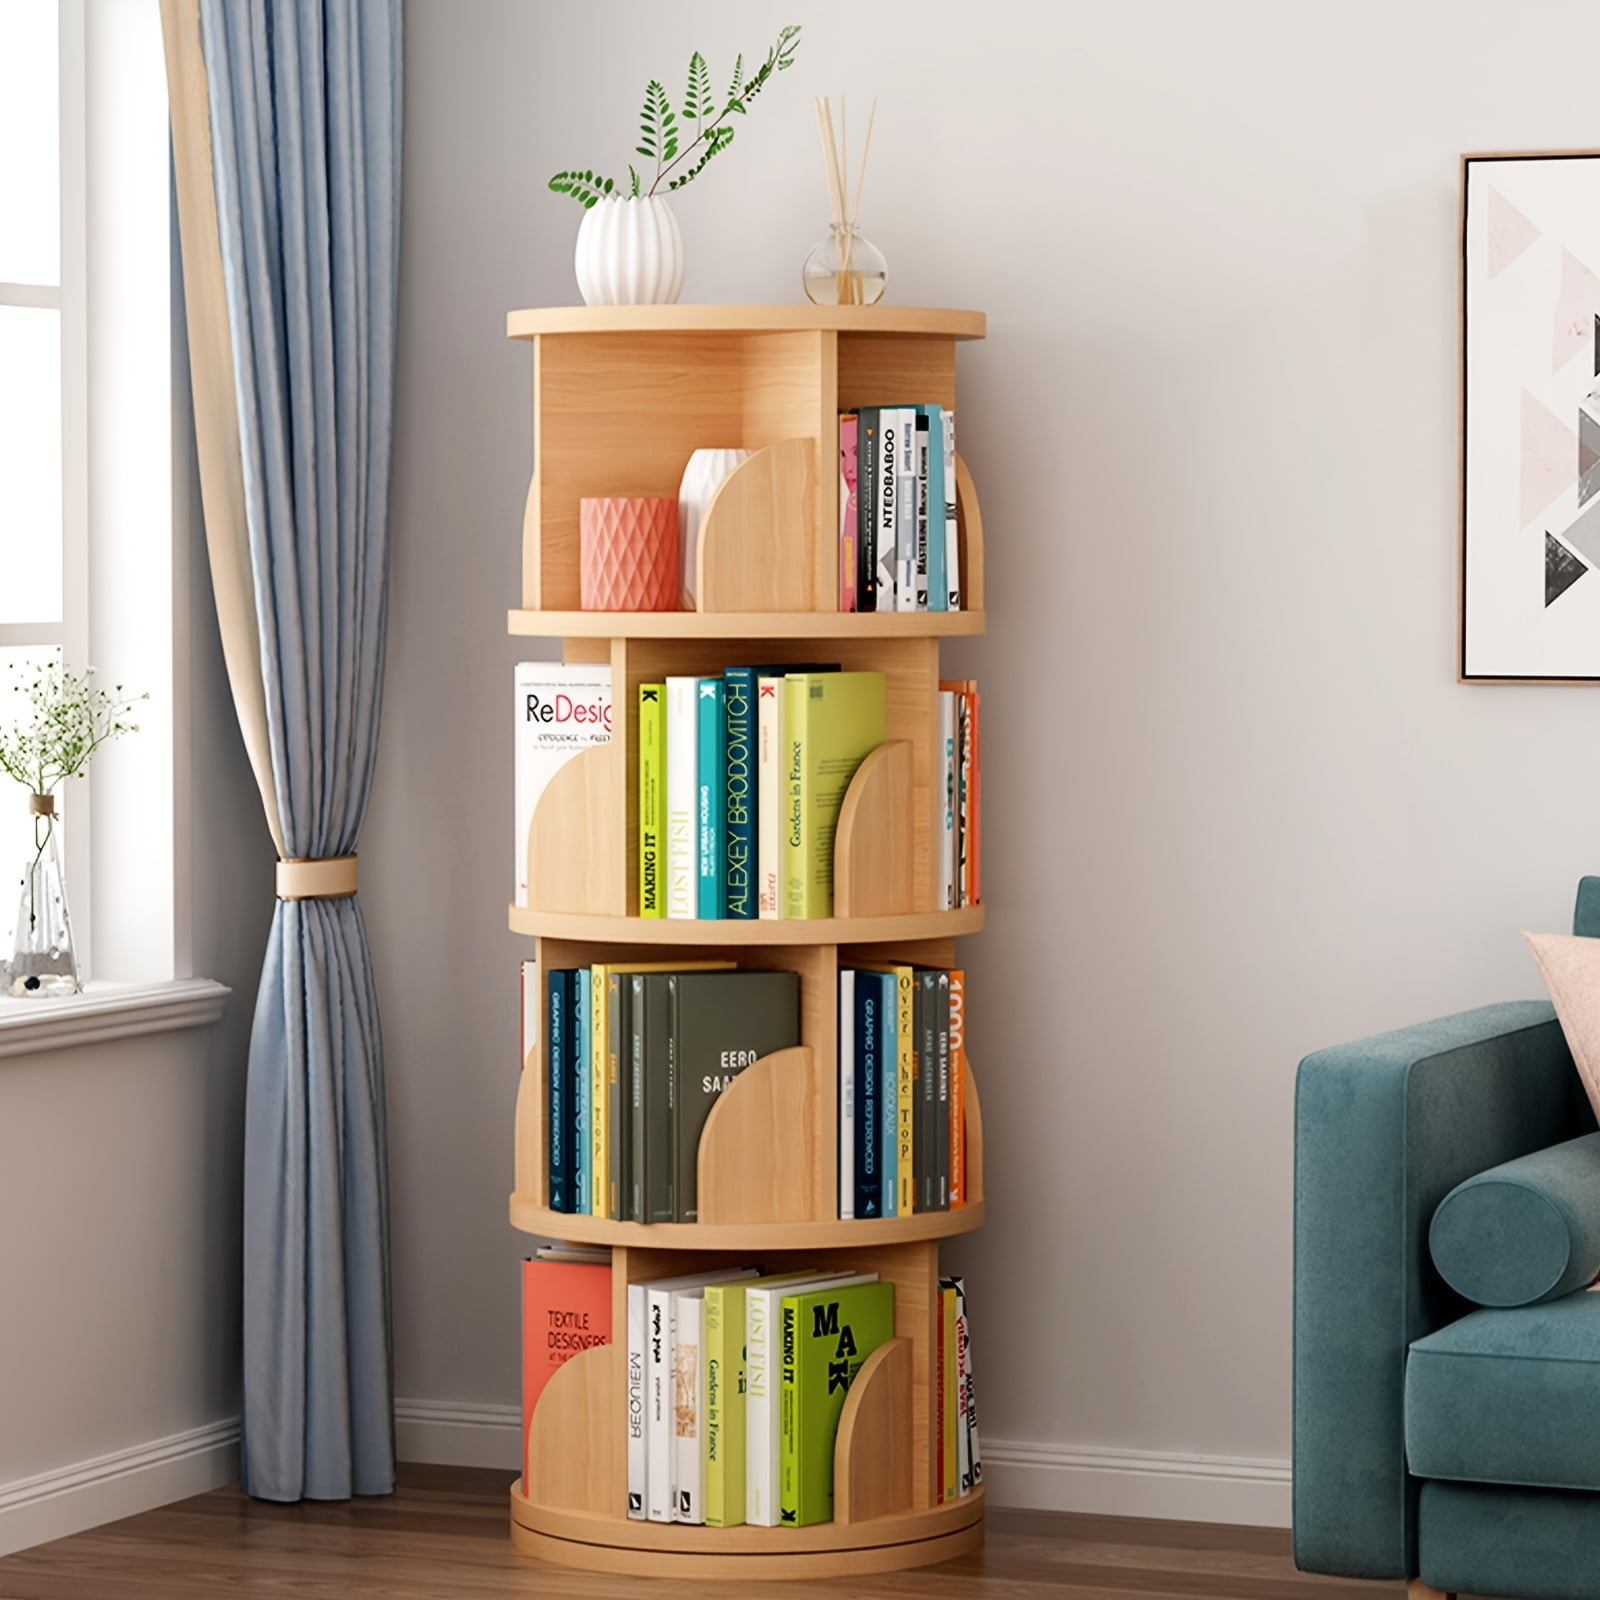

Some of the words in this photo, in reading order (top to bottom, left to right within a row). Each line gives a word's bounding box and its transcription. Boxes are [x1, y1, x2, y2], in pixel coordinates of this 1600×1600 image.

[883, 429, 895, 528] NTEDBABOO
[728, 684, 748, 824] BRODOVITCH
[790, 741, 801, 782] France
[790, 784, 801, 796] in
[644, 833, 656, 847] IT
[672, 811, 689, 855] FISH
[790, 800, 801, 847] Gardens
[644, 850, 656, 910] MAKING
[672, 859, 689, 914] LOST
[728, 830, 748, 915] ALEXEY
[865, 999, 873, 1050] GRAPHIC
[949, 979, 962, 1051] 1000
[721, 1050, 757, 1068] EERO
[865, 1053, 873, 1095] DESIGN
[702, 1075, 737, 1093] SAA
[548, 1310, 589, 1330] TEXTILE
[750, 1296, 765, 1349] LOST
[784, 1308, 794, 1366] MAKING
[709, 1359, 719, 1405] Gardens
[750, 1353, 765, 1397] FISH
[784, 1369, 794, 1384] IT
[709, 1408, 719, 1420] in
[709, 1423, 719, 1462] France
